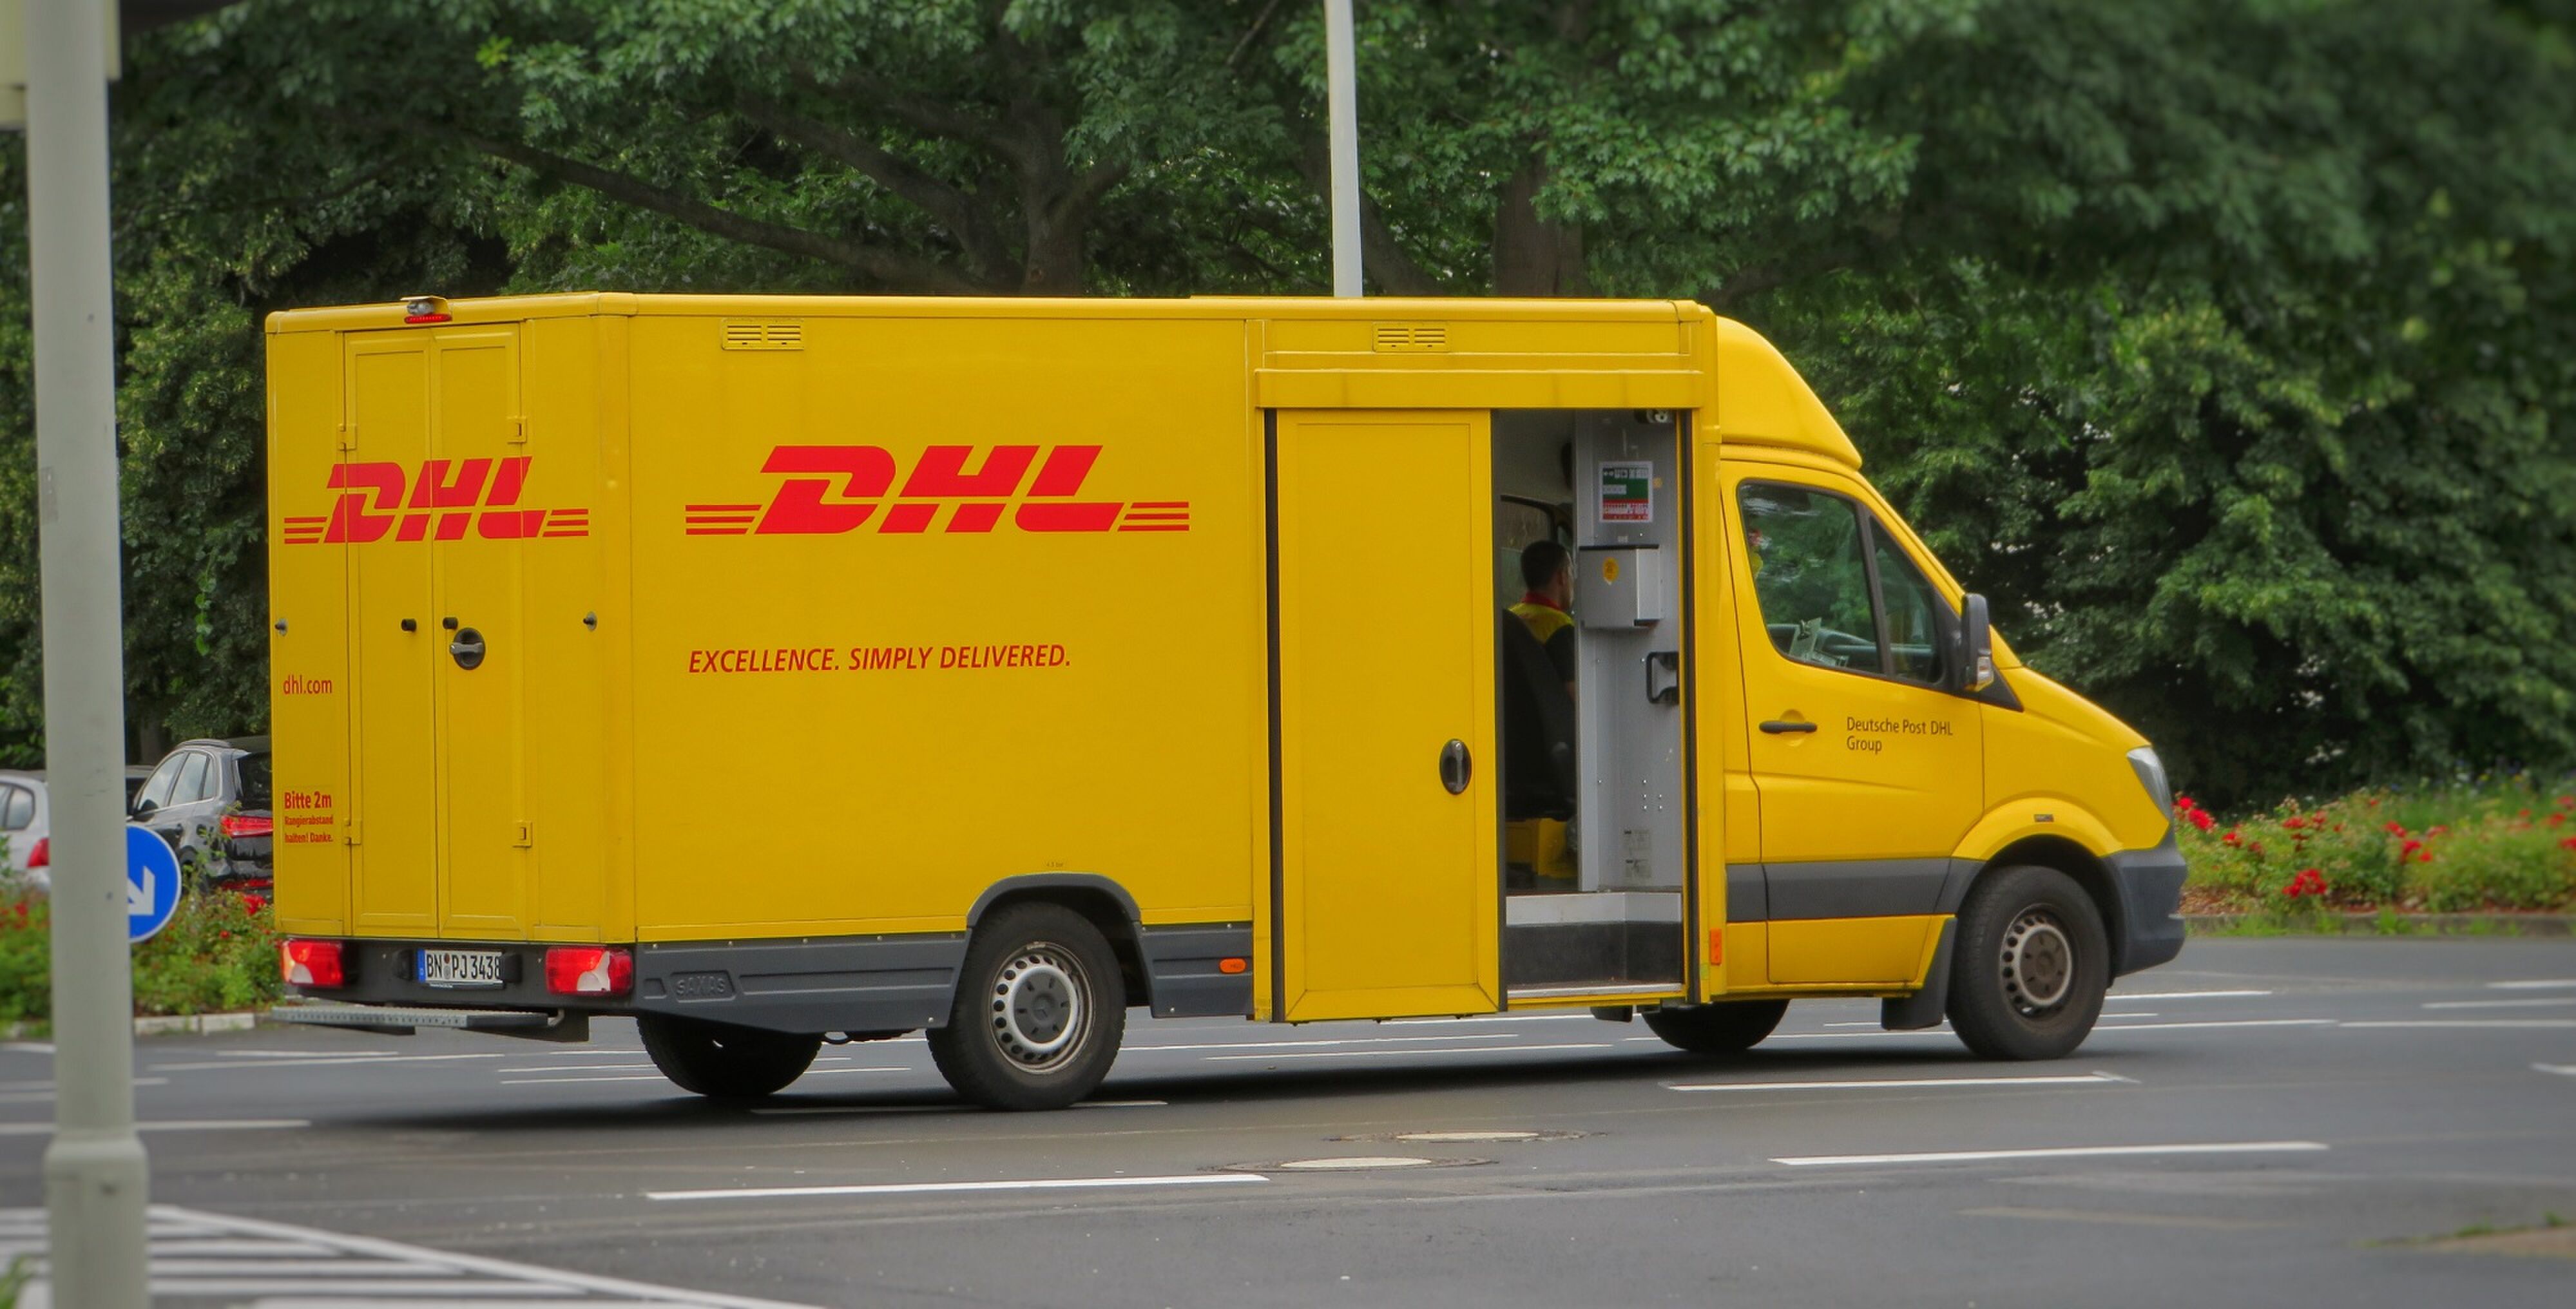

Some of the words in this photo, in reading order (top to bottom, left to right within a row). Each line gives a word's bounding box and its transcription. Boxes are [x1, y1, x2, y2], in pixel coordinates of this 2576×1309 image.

[323, 456, 546, 543] DHL
[753, 445, 1125, 534] DHL
[688, 647, 840, 674] EXCELLENCE.
[848, 647, 935, 672] SIMPLY
[939, 644, 1071, 669] DELIVERED.
[284, 674, 332, 694] dhl.com
[1847, 716, 1899, 733] Deutsche
[1902, 719, 1927, 735] Post
[1930, 720, 1954, 736] DHL
[1847, 736, 1883, 755] Group
[284, 790, 311, 809] Bitte
[314, 790, 332, 808] 2m
[309, 832, 334, 843] Danke.
[426, 953, 443, 978] BN
[452, 955, 467, 979] PJ
[470, 955, 502, 980] 3438
